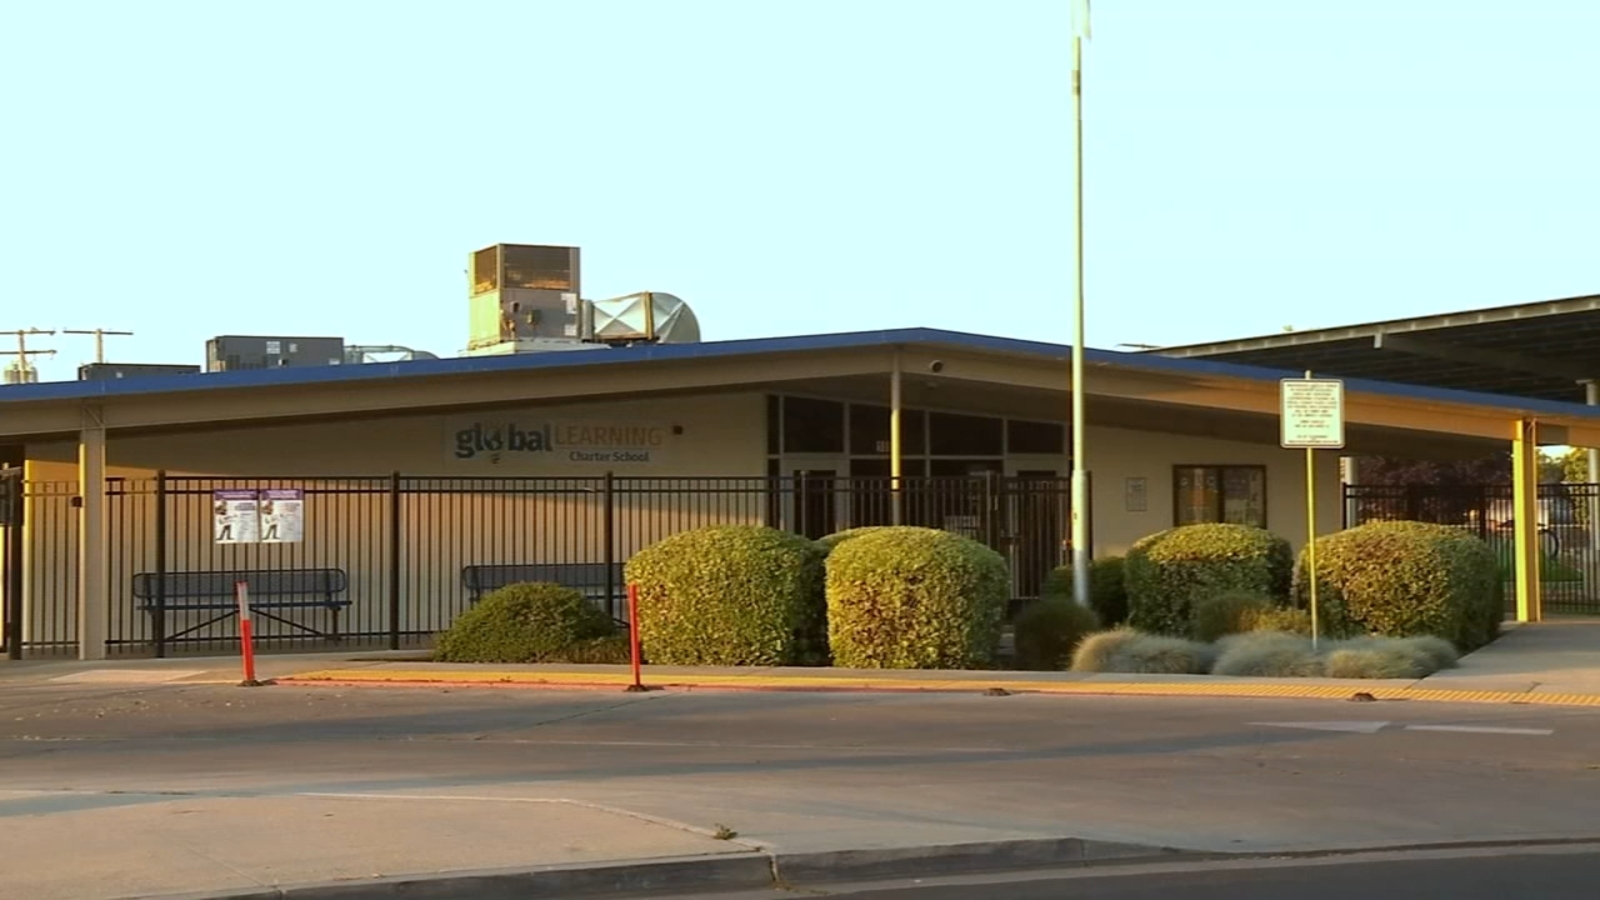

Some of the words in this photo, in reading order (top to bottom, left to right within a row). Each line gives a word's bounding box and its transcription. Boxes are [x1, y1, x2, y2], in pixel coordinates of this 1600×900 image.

[554, 425, 663, 446] LEARNING
[569, 450, 610, 462] Charter
[612, 451, 649, 462] School
